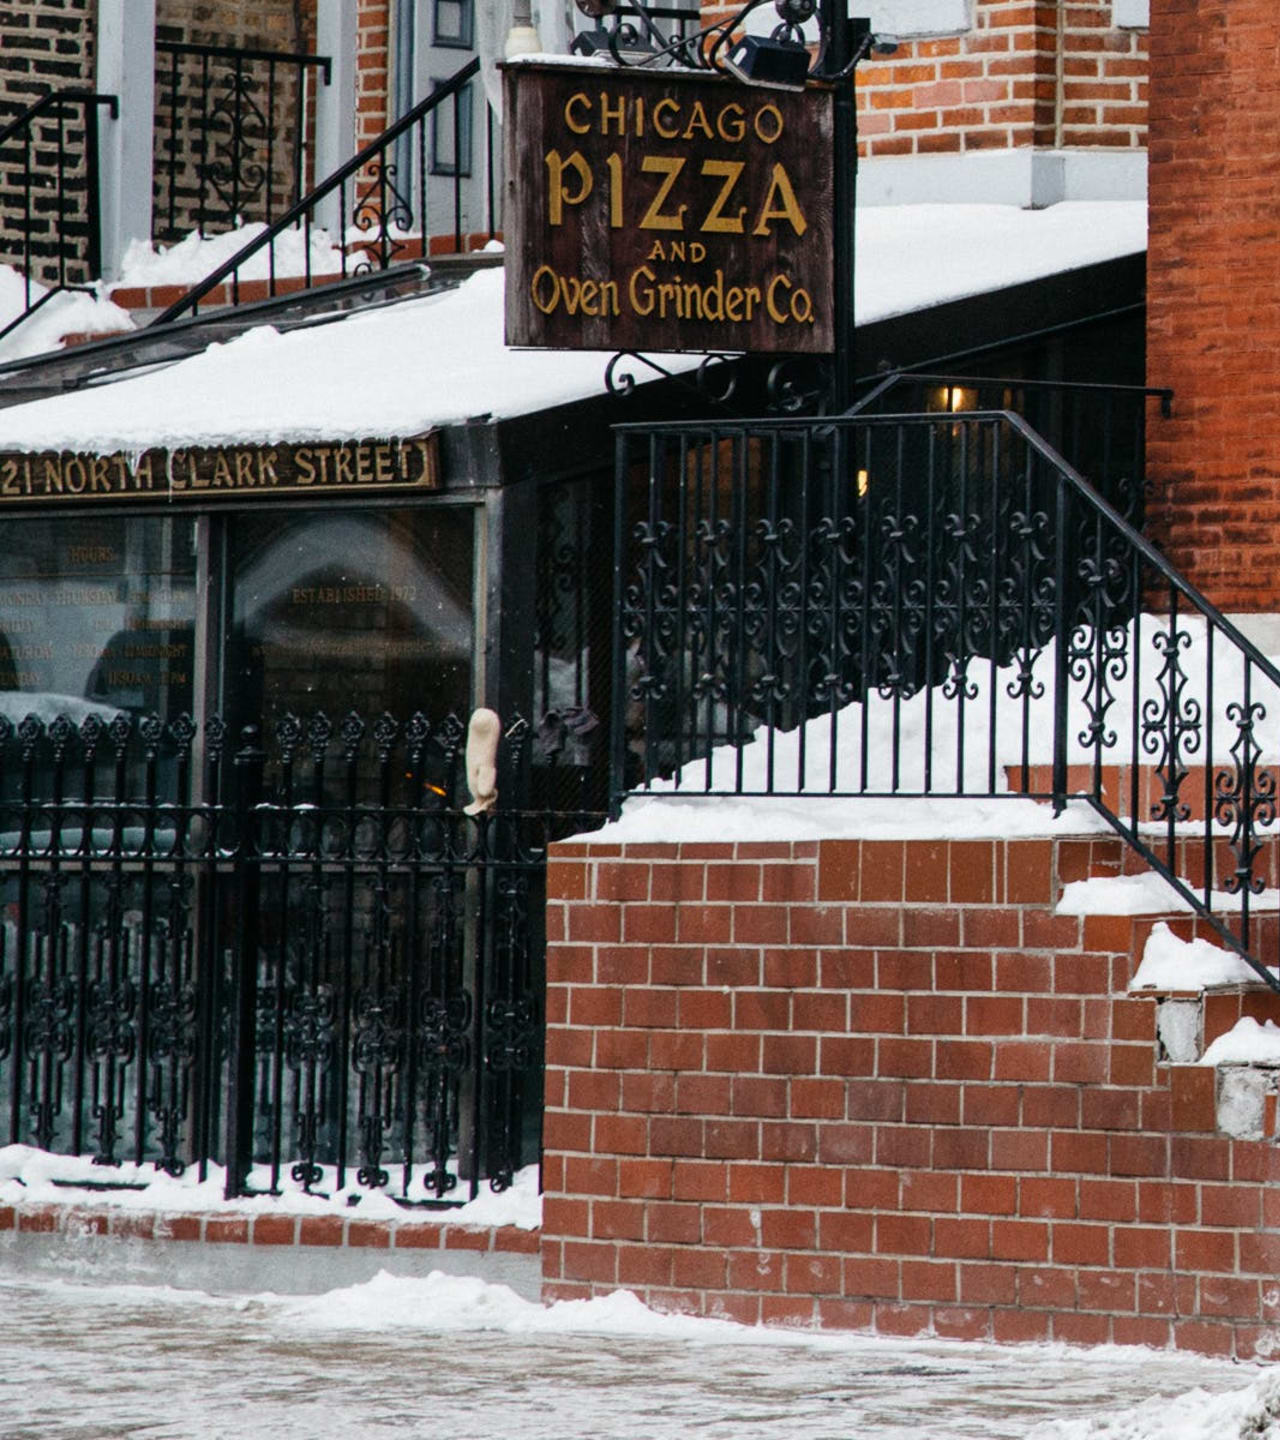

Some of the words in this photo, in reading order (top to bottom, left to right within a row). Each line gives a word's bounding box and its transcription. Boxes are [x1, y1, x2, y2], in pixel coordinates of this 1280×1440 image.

[565, 92, 783, 144] CHICAGO
[545, 149, 808, 236] PIZZA
[647, 239, 706, 264] AND
[531, 265, 620, 317] Oven
[629, 265, 762, 323] Grinder
[766, 273, 815, 324] Co.
[45, 455, 152, 494] NORTH
[169, 451, 280, 489] CLARK
[294, 444, 413, 484] STREET
